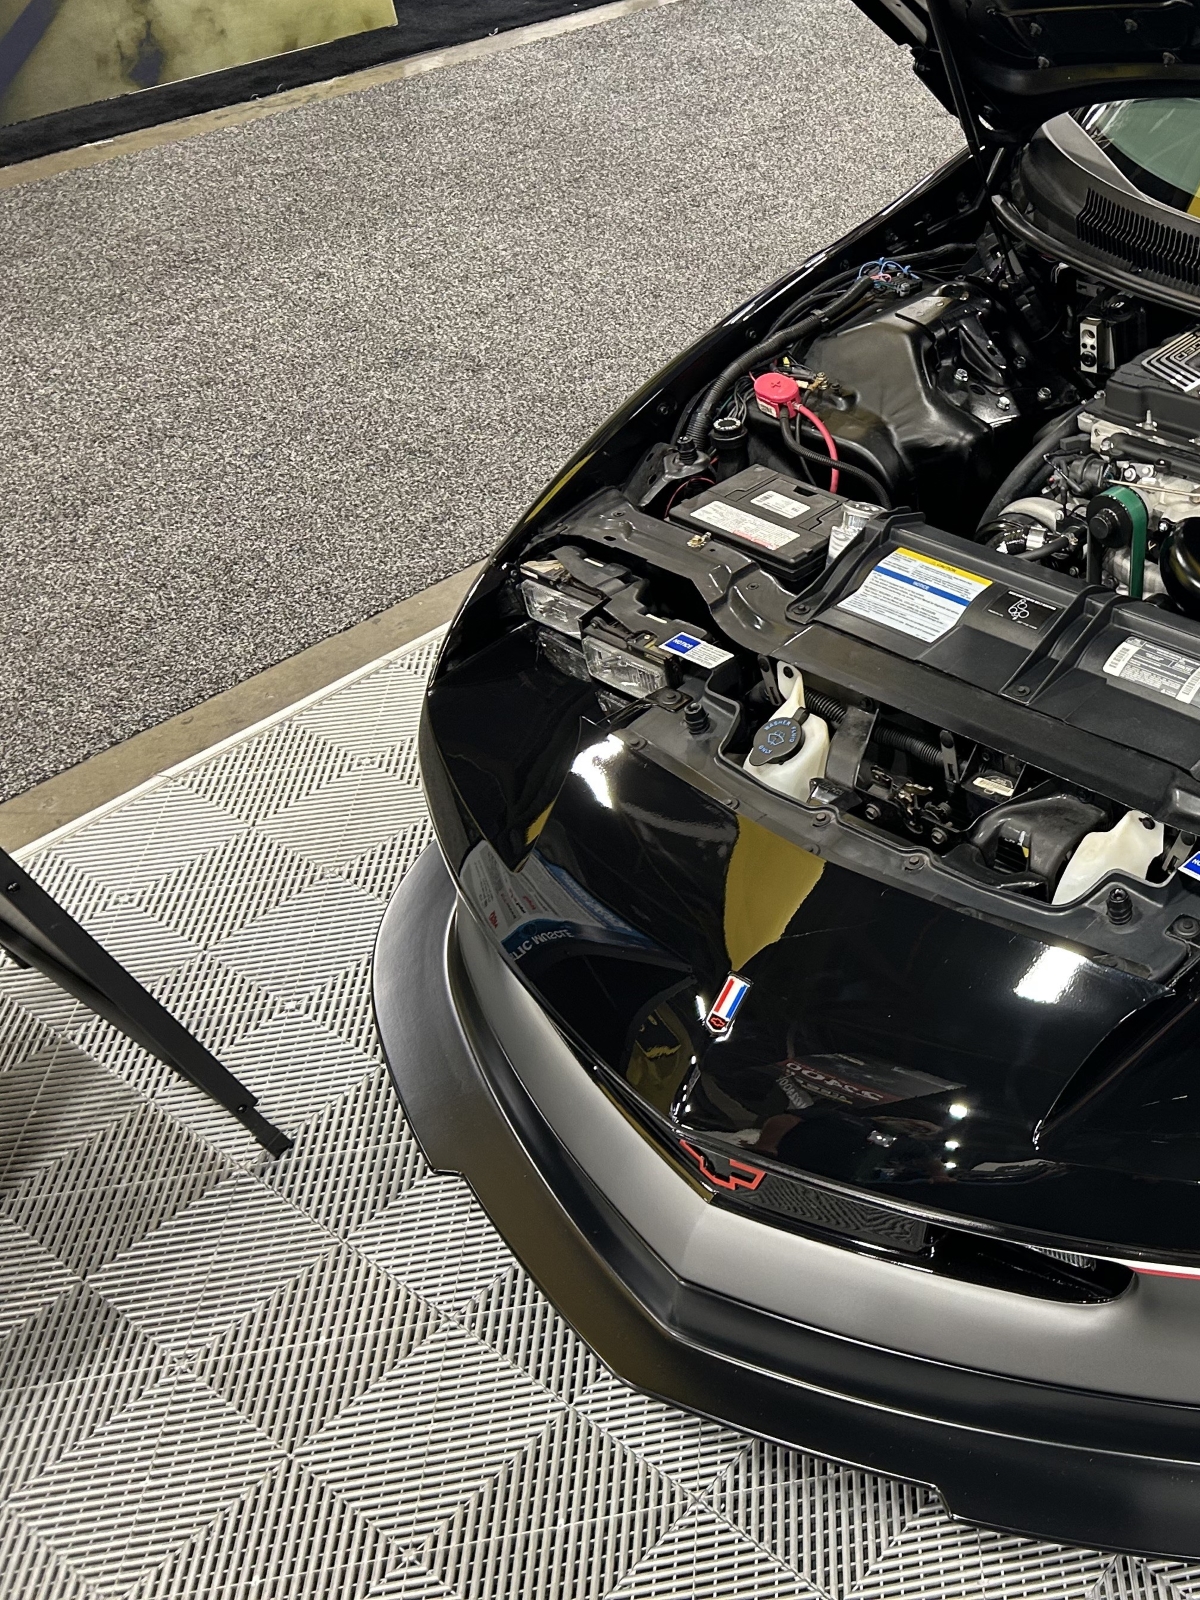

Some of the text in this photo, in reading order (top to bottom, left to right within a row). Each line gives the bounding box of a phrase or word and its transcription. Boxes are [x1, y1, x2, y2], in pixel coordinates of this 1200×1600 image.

[672, 637, 695, 650] NOTICE
[758, 719, 798, 755] WASHER FLUID ONLY
